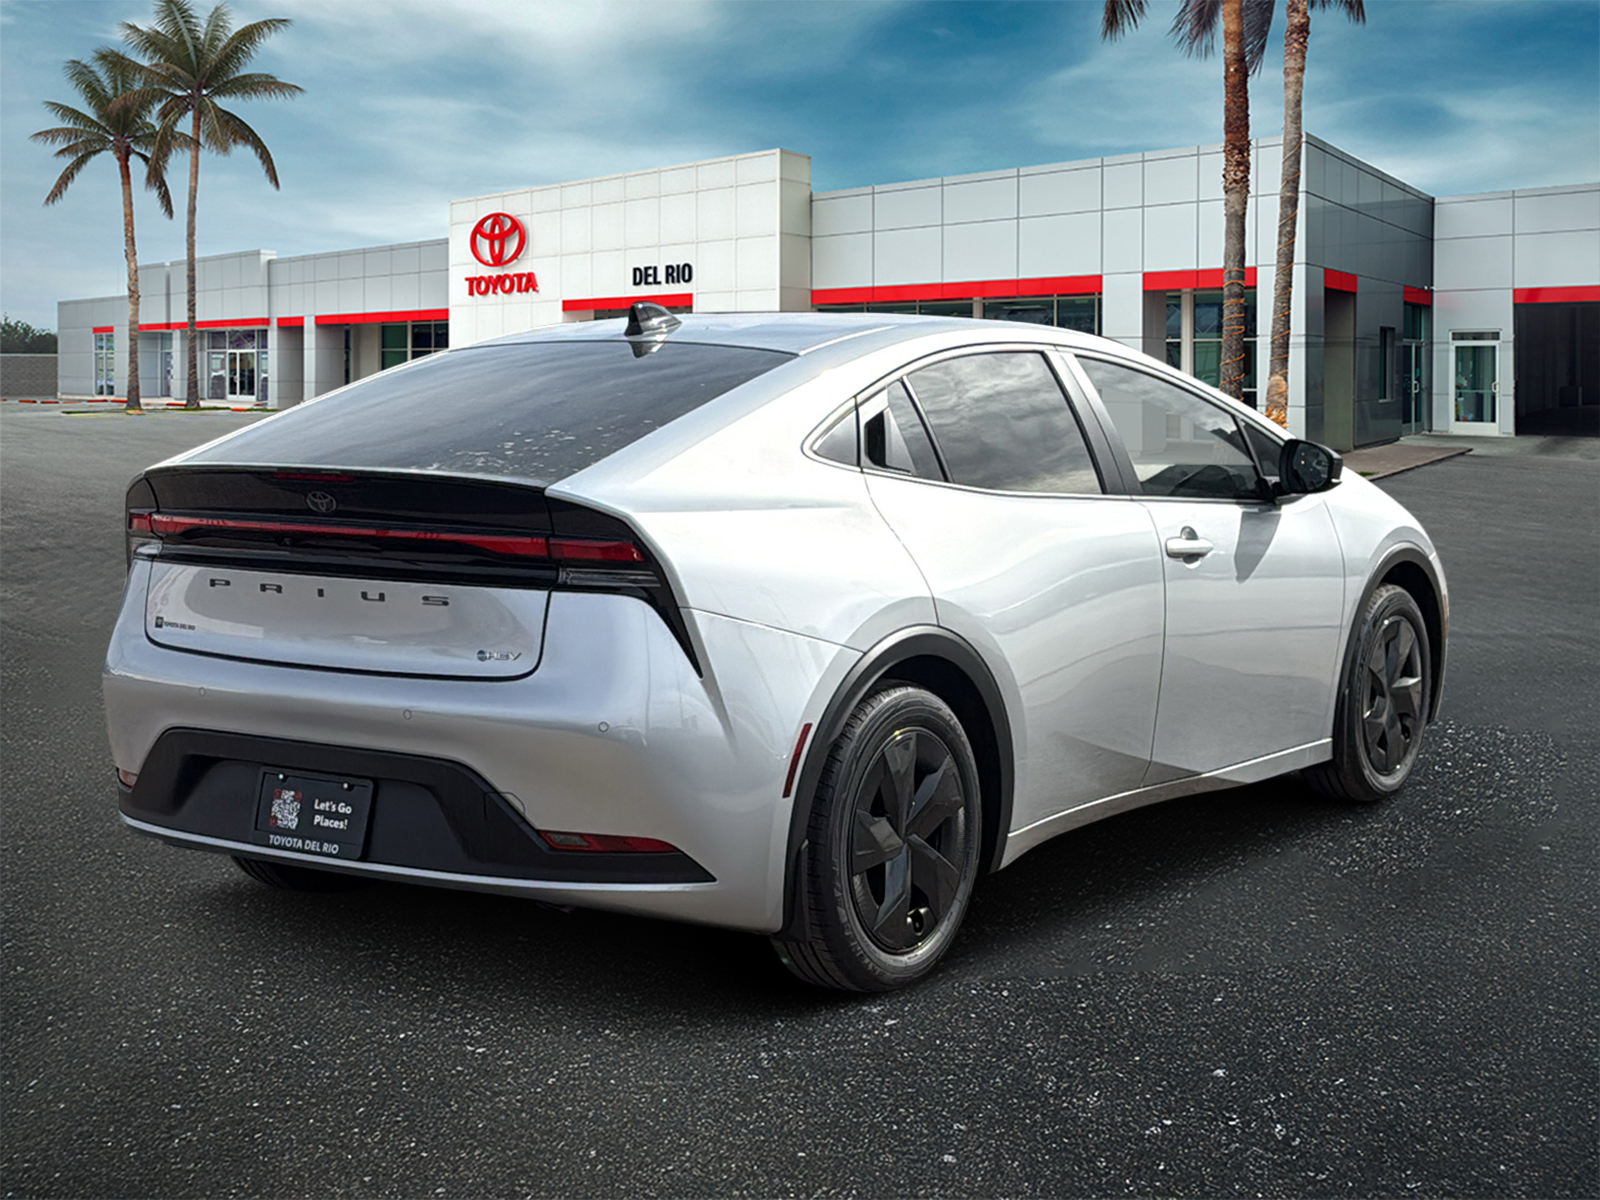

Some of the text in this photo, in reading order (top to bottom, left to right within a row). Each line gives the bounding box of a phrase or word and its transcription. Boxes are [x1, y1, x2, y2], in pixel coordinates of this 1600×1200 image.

[465, 272, 539, 296] TOYOTA
[632, 263, 693, 286] DEL RIO
[209, 578, 450, 607] PRIUS
[314, 799, 352, 814] Let's Go
[313, 815, 348, 830] Places!
[269, 834, 339, 854] TOYOTA DEL RIO
